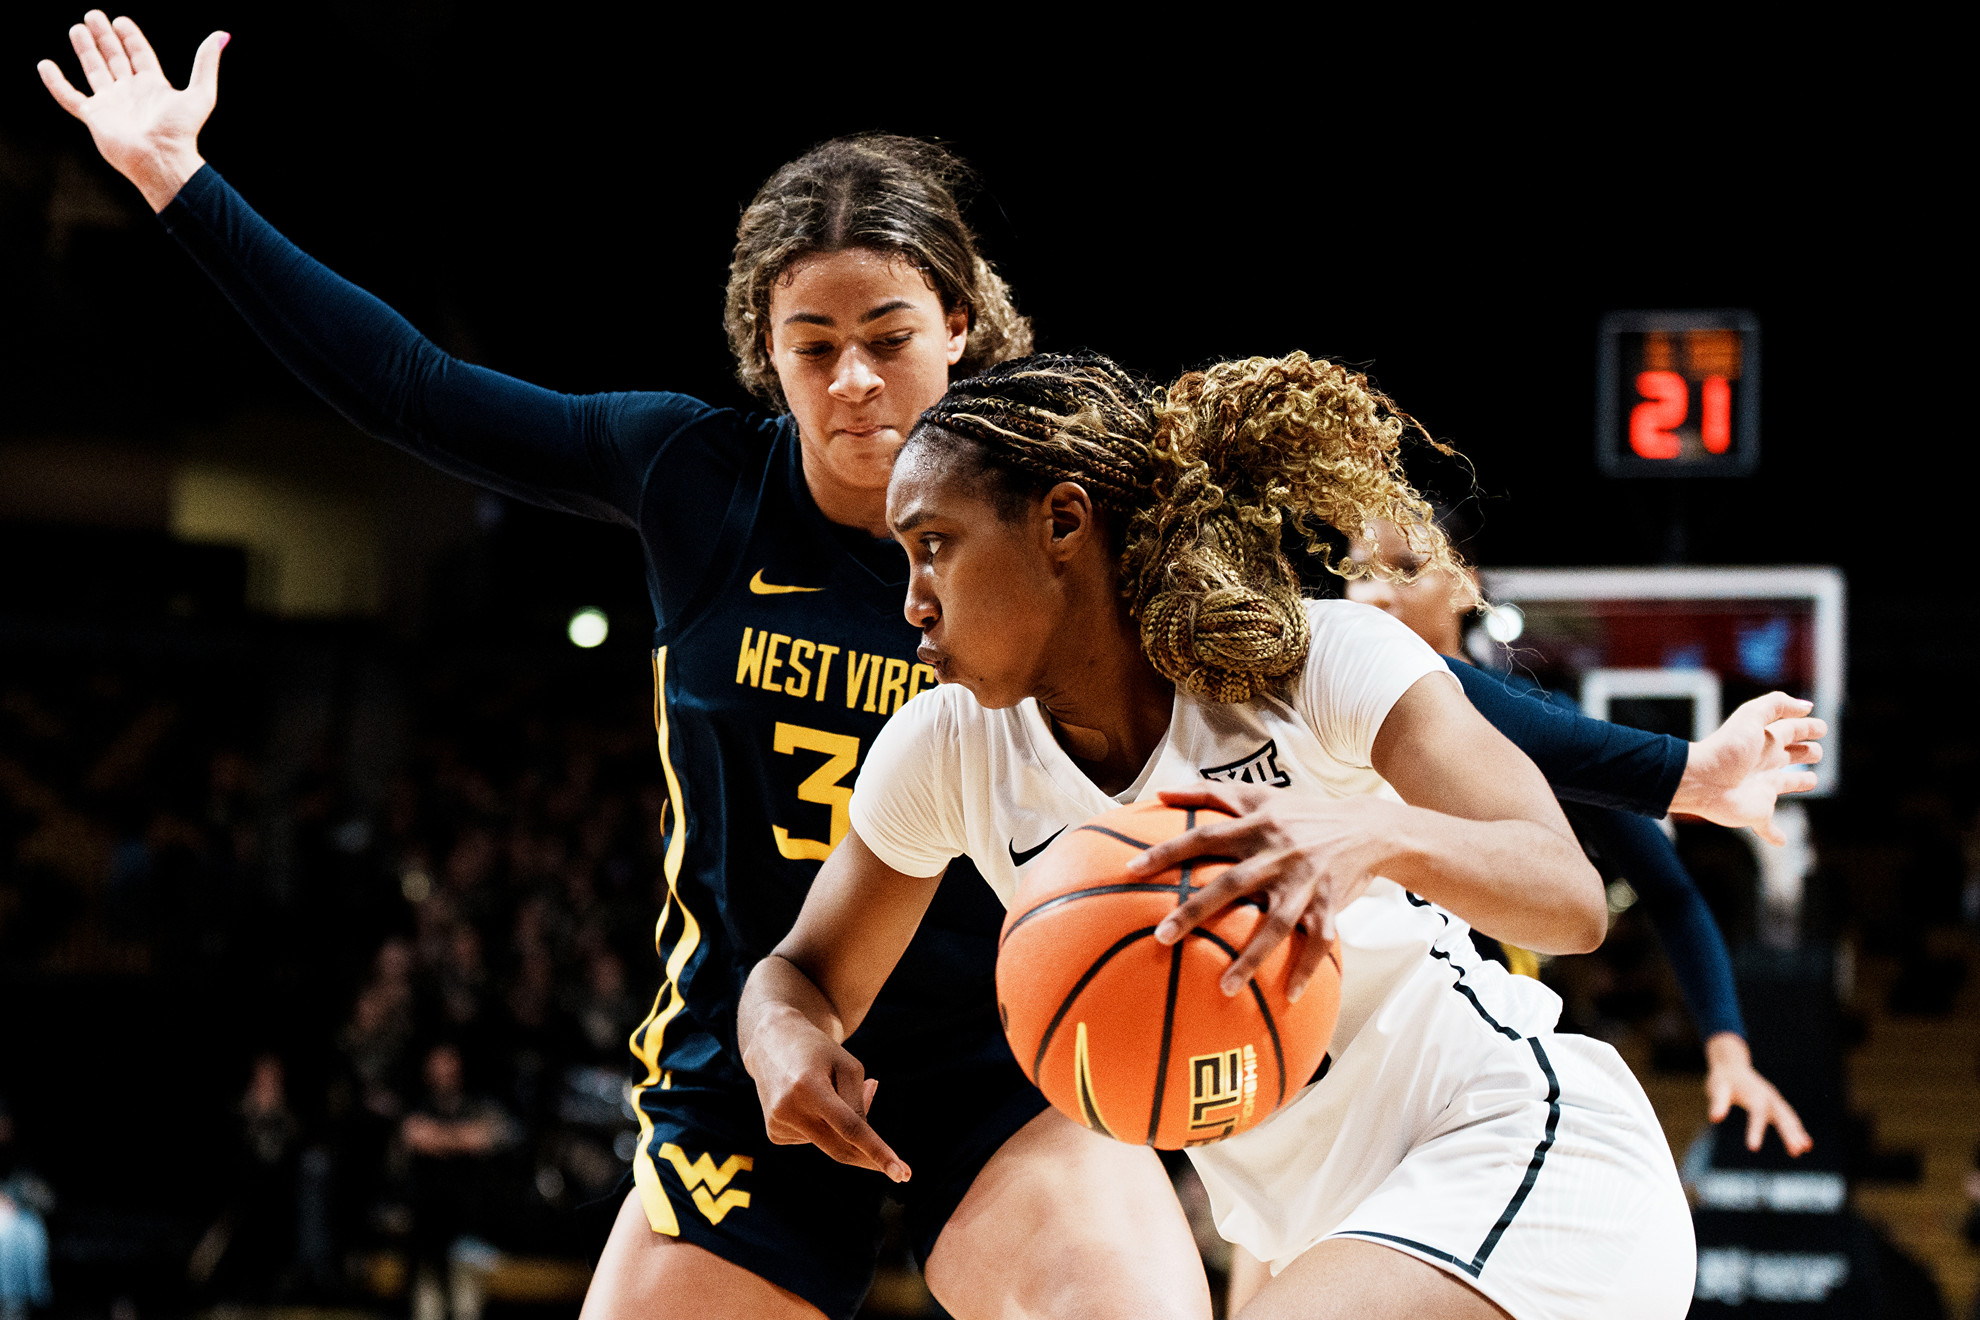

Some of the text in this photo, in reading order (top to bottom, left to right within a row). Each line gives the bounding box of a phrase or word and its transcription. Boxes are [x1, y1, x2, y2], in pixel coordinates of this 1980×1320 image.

[1629, 370, 1732, 460] 21
[735, 626, 941, 716] WEST VIRG
